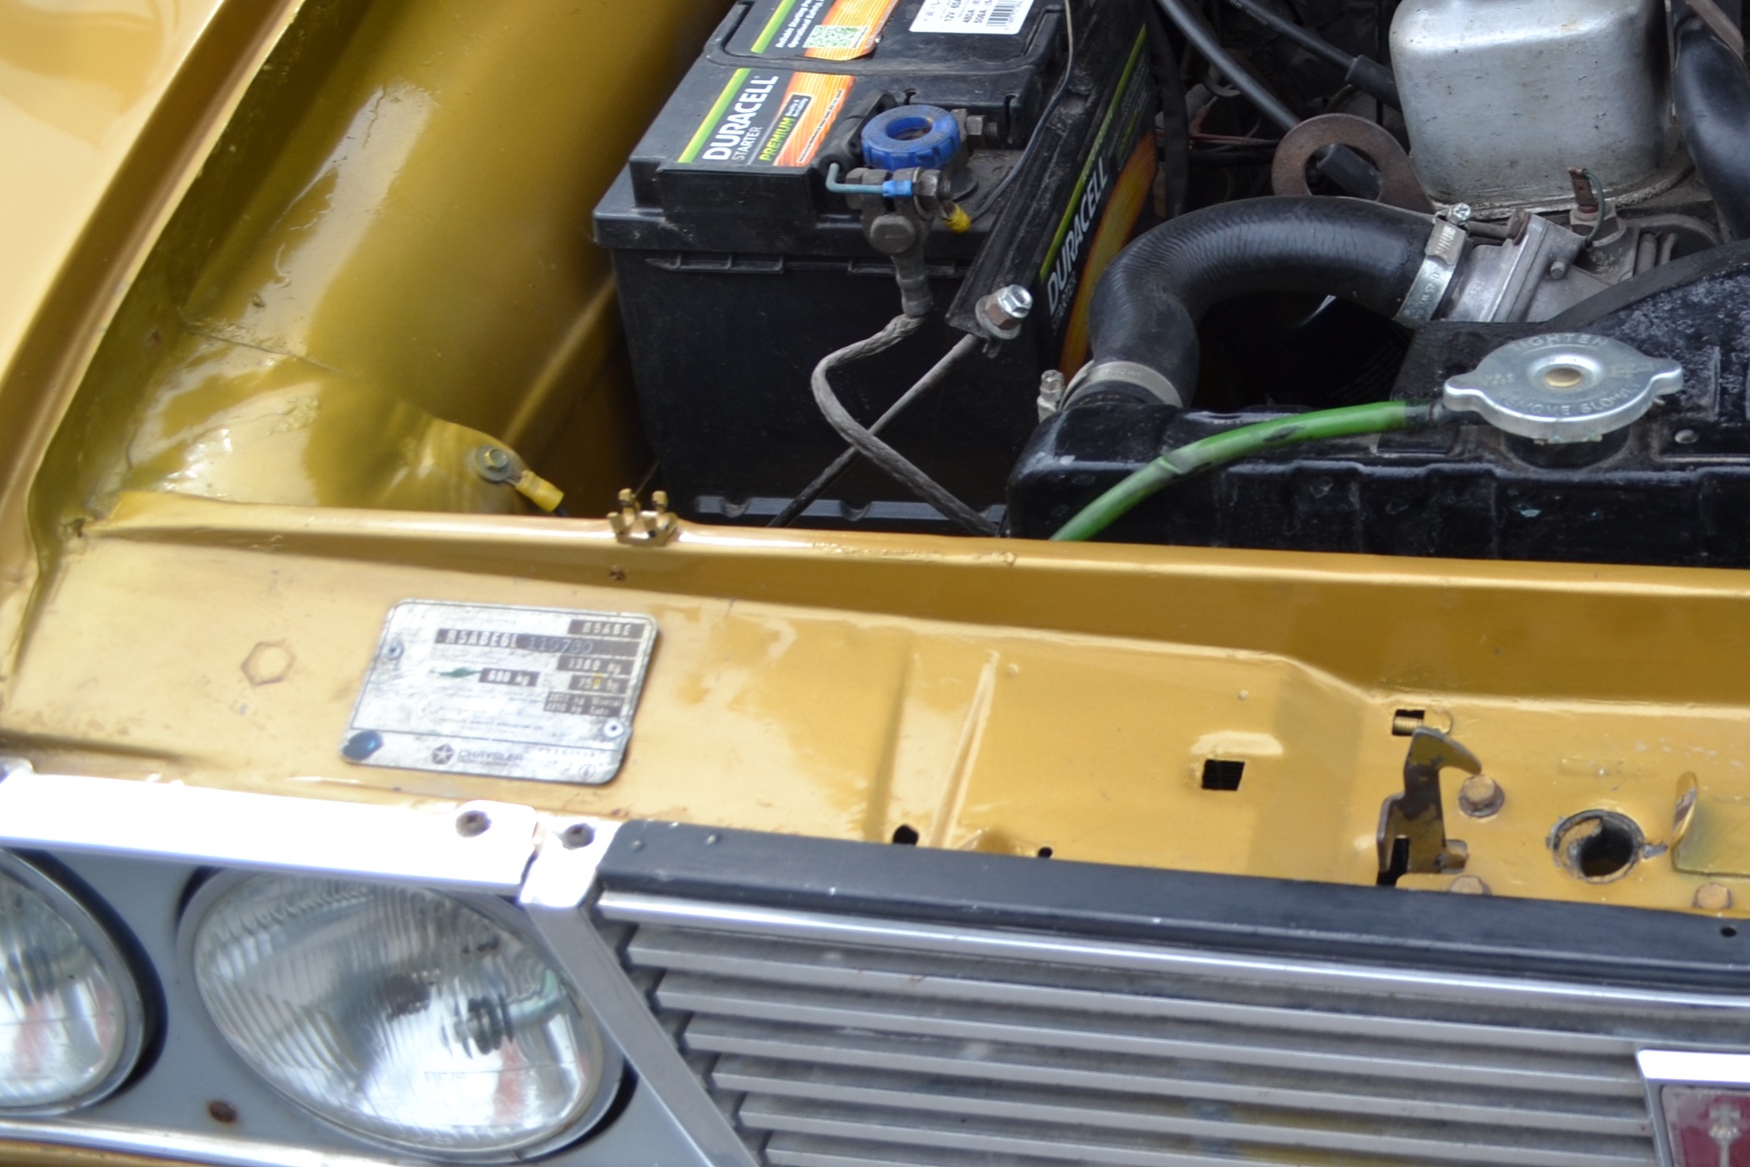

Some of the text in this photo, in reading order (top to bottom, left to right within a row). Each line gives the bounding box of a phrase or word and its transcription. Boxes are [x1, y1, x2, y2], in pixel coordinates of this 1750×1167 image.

[702, 75, 779, 161] DURACELL
[731, 126, 763, 161] STARTER
[758, 117, 796, 162] PREMIUM
[1047, 156, 1109, 317] DURACELL
[1510, 333, 1610, 353] TIGHTEN
[515, 672, 531, 687] kg
[458, 749, 524, 762] CHRYSLER
